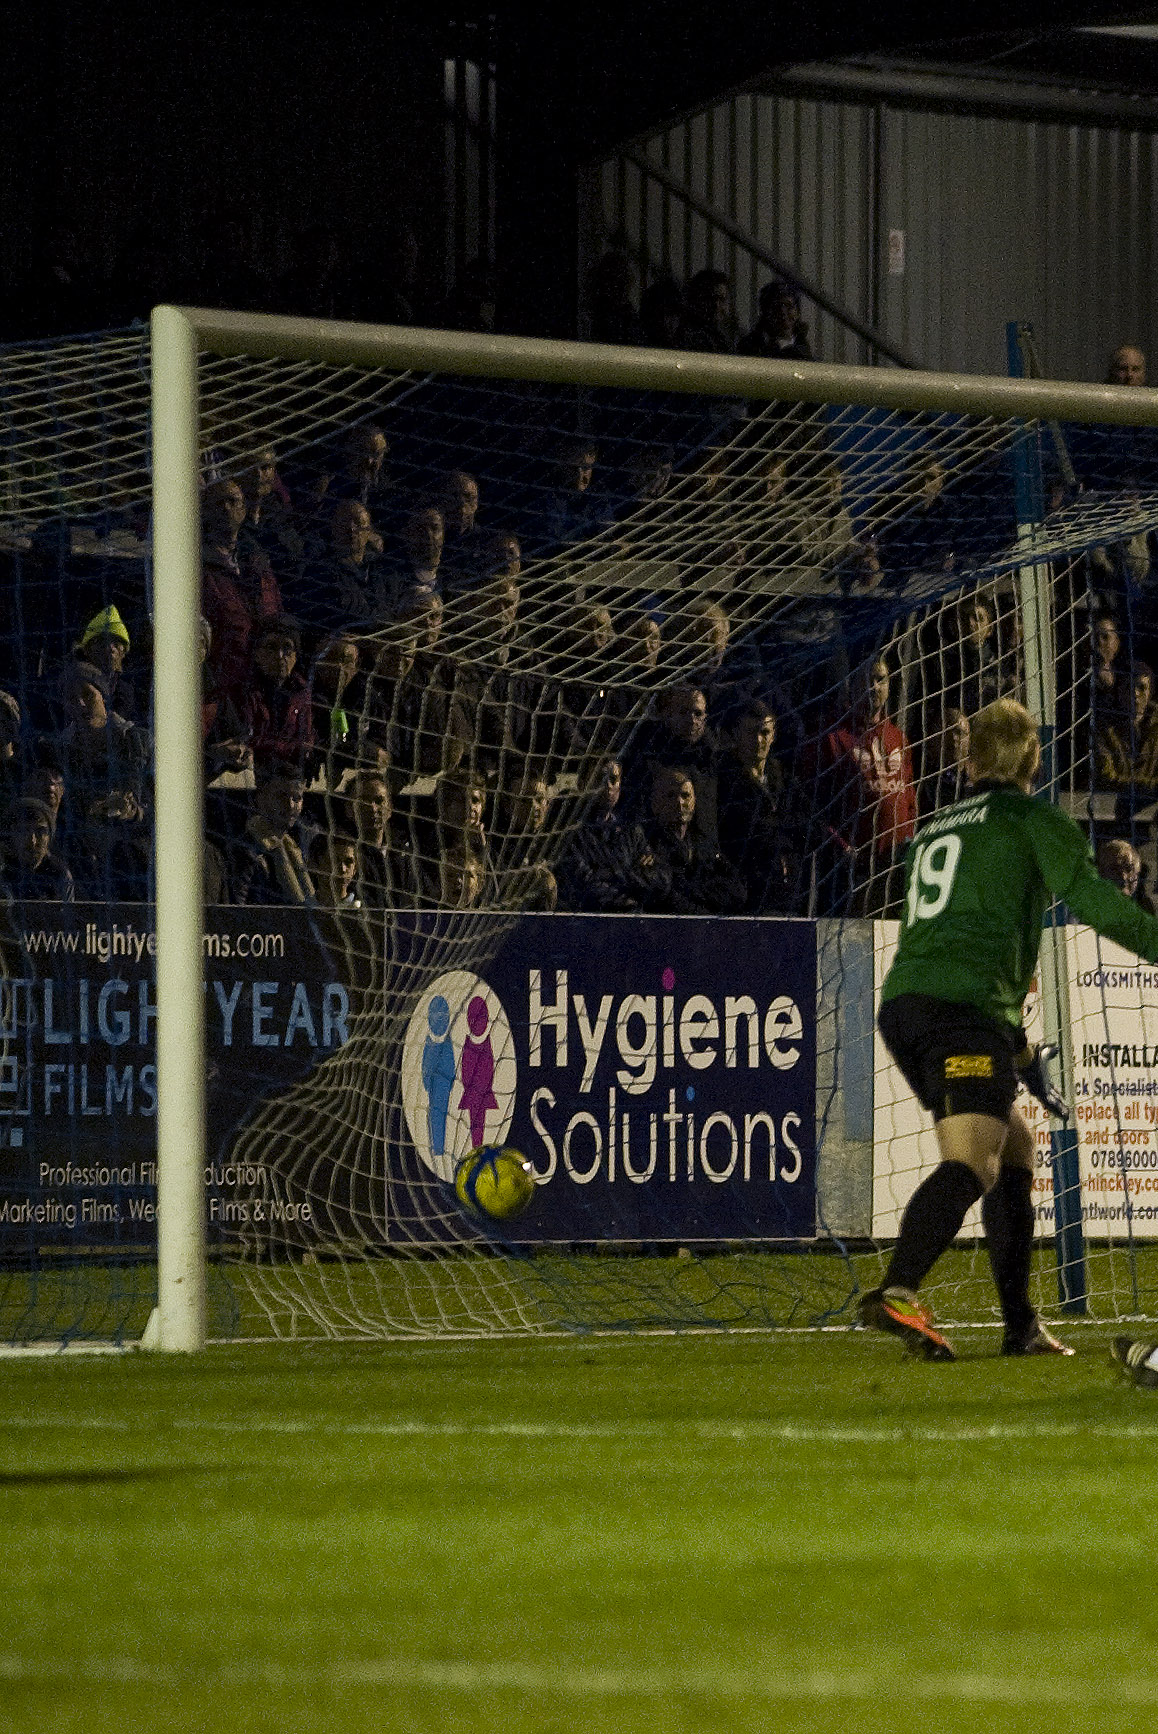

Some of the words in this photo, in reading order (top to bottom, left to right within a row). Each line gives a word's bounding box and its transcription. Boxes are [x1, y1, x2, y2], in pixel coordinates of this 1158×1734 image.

[907, 834, 962, 927] 19
[23, 923, 285, 963] www.lightyems.com
[528, 967, 803, 1095] Hygiene
[44, 1063, 158, 1117] FILMS
[1077, 1101, 1120, 1124] eplace
[1124, 1101, 1140, 1121] all
[530, 1085, 802, 1185] Solutions
[1085, 1126, 1109, 1145] and
[1113, 1127, 1149, 1145] doors
[40, 1161, 137, 1187] Professional
[140, 1161, 159, 1186] Fil
[204, 1161, 267, 1187] duction
[210, 1198, 250, 1222] Films
[254, 1198, 267, 1222] &
[271, 1200, 313, 1222] More
